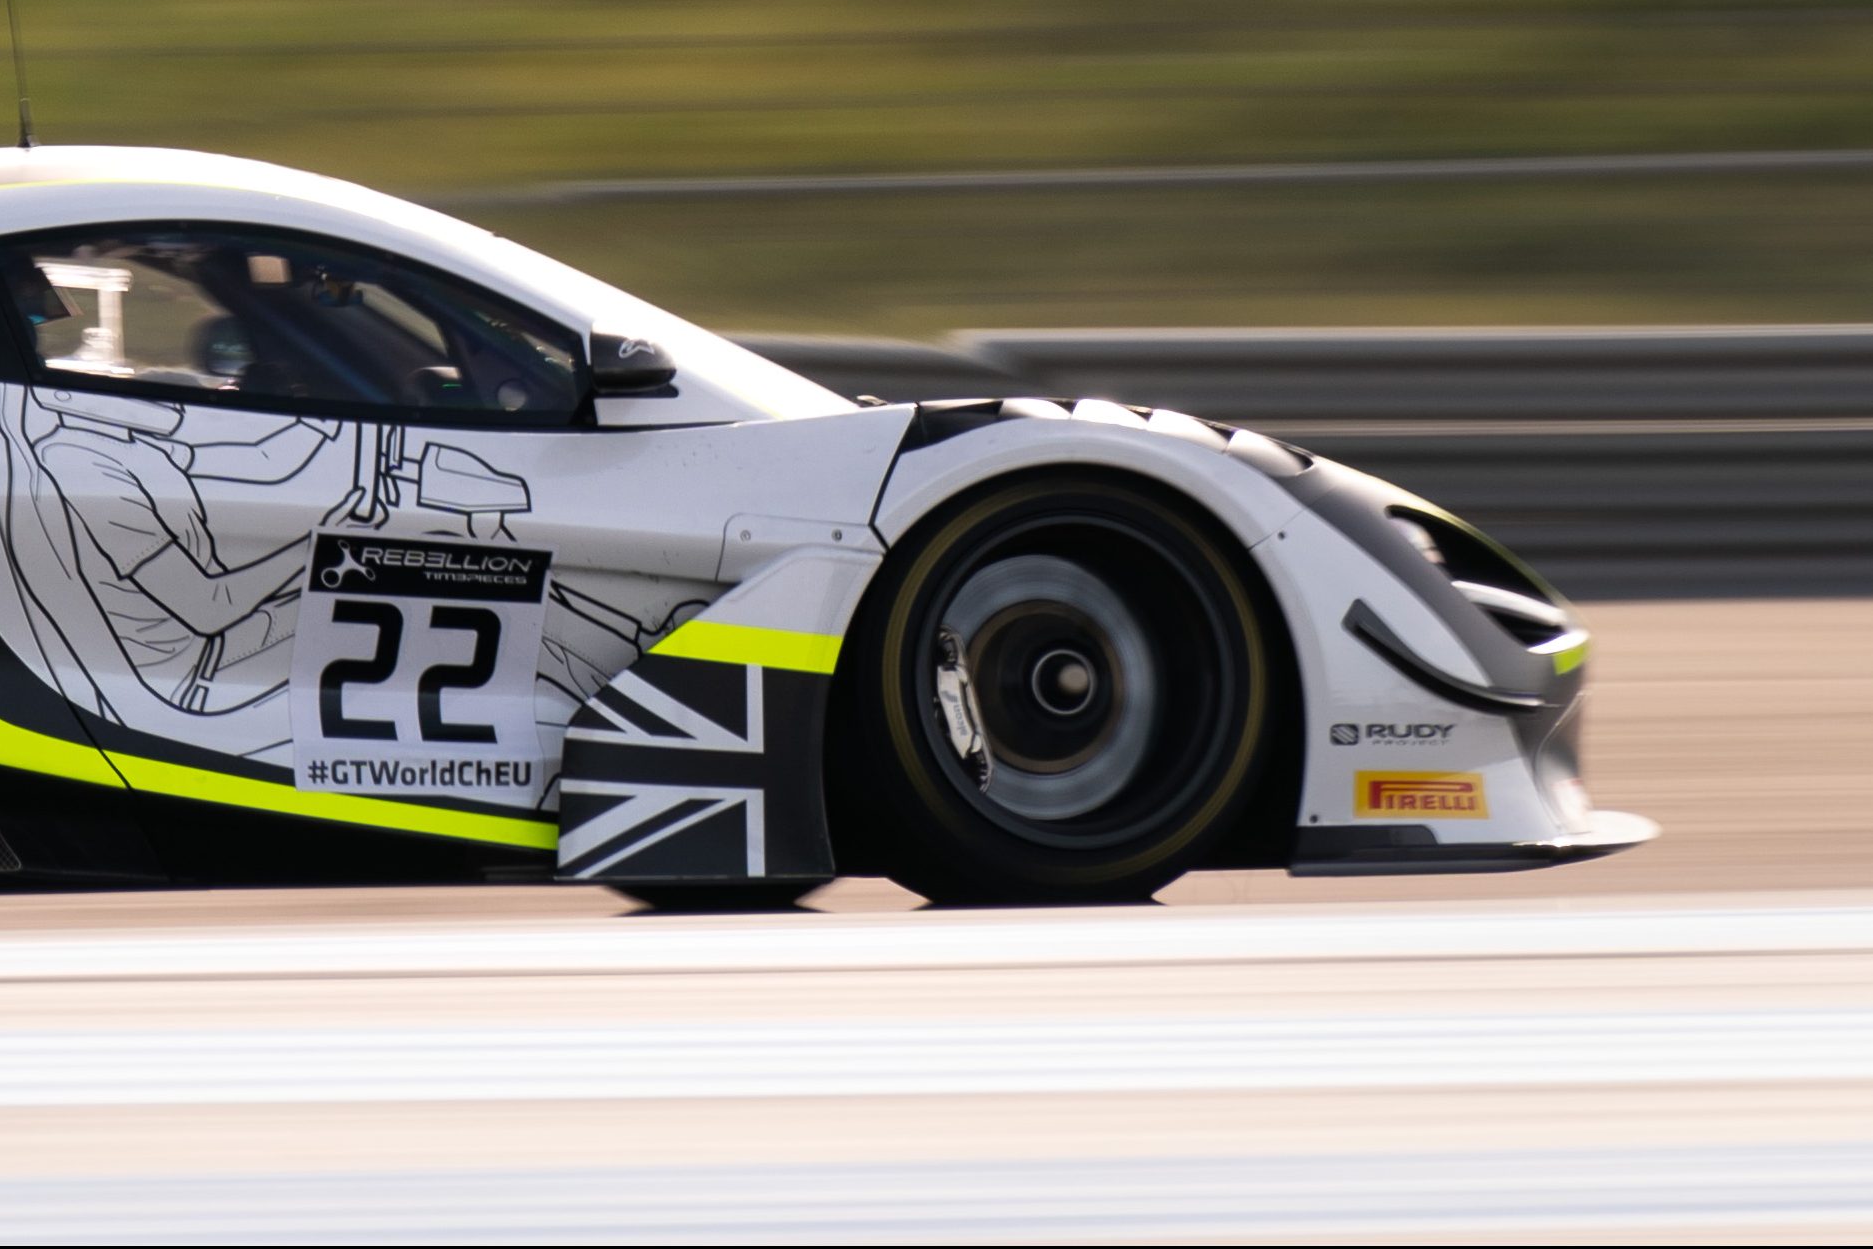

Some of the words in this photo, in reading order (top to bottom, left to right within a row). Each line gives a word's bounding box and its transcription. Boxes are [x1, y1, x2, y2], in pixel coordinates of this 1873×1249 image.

[361, 547, 531, 573] REBELLION
[319, 599, 502, 744] 22
[1366, 724, 1455, 738] RUDY
[308, 760, 532, 787] #GTWorldChEU
[1368, 780, 1477, 810] PIRELLI
